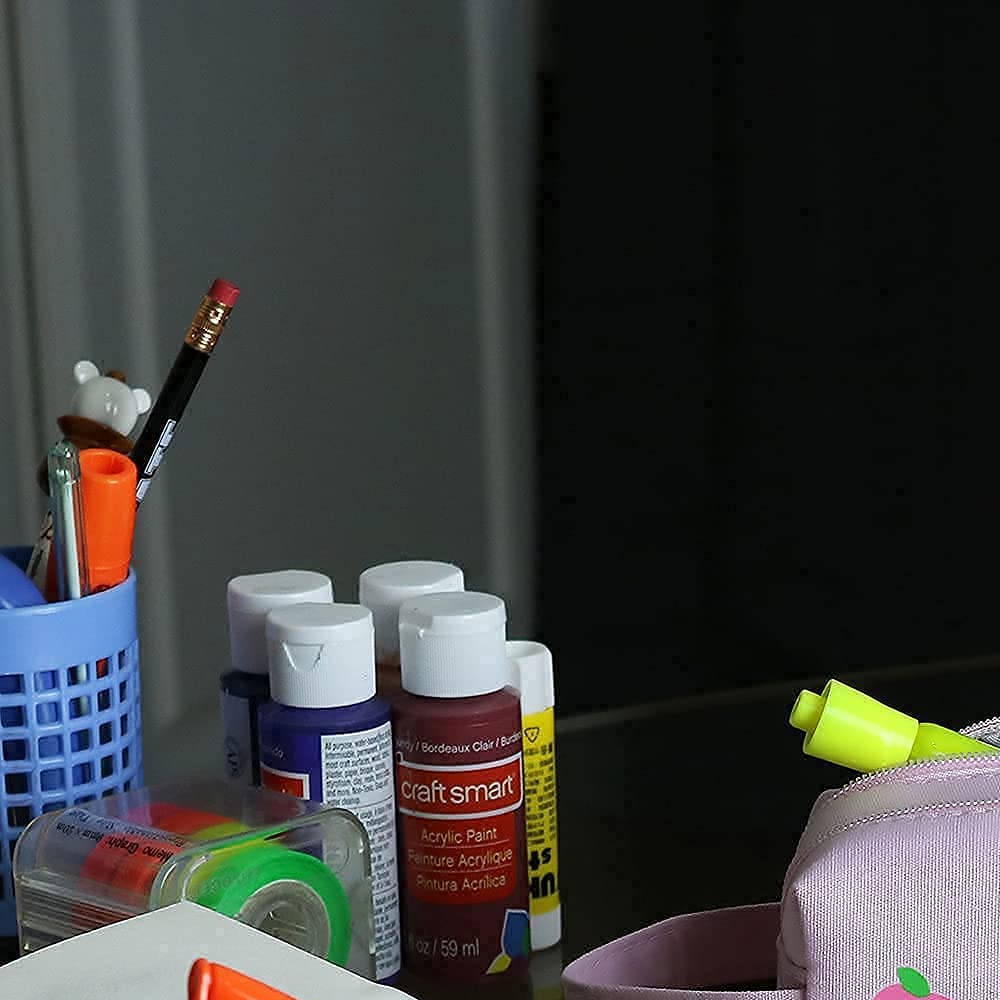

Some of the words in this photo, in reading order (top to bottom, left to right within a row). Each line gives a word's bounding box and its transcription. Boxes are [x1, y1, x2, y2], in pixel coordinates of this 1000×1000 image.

[421, 742, 471, 754] Bordeaux
[472, 740, 494, 752] Clair
[401, 780, 447, 803] craft
[449, 775, 514, 804] smart
[421, 828, 463, 849] Acrylic
[466, 827, 497, 843] Paint
[142, 846, 174, 864] Memo
[408, 849, 454, 868] Peinture
[458, 848, 513, 869] Acrylique
[529, 847, 551, 871] st
[416, 874, 458, 892] Pintura
[529, 872, 555, 899] UH
[416, 940, 429, 953] oz
[440, 938, 458, 957] 59
[462, 937, 479, 957] ml
